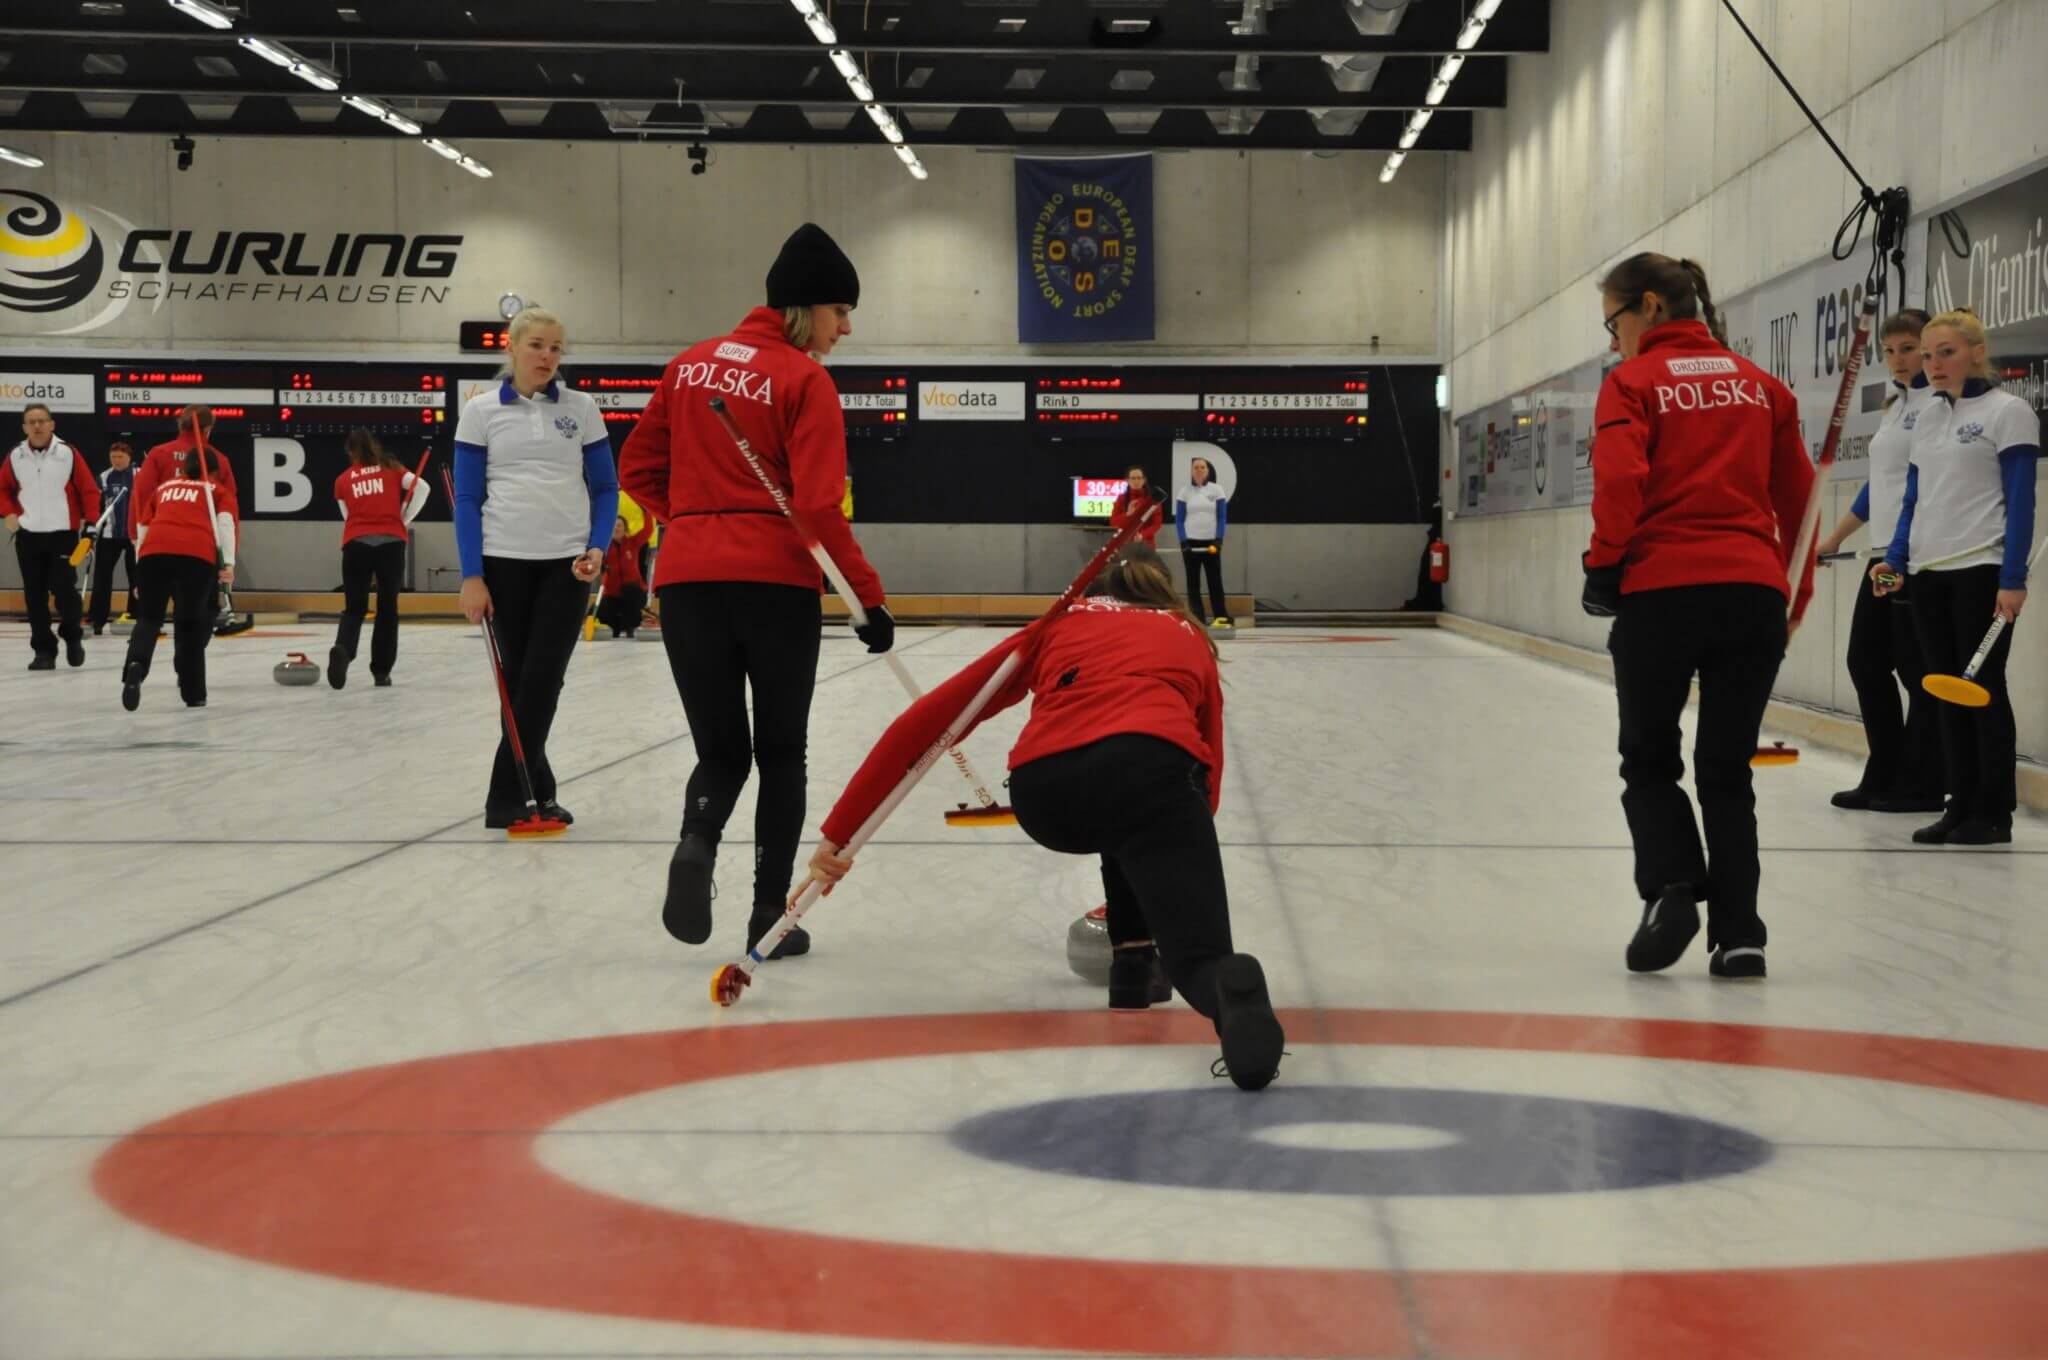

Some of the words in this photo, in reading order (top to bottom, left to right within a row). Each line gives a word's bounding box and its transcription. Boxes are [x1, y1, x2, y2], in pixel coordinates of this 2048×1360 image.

[1072, 183, 1136, 239] EUROPEAN
[118, 229, 465, 278] CURLING
[1032, 193, 1064, 309] ORGANIZATION
[1121, 245, 1137, 287] DEAF
[107, 279, 452, 305] SCHAFFHAUSEN
[1073, 289, 1123, 317] SPORT
[0, 380, 65, 399] todata
[112, 389, 139, 401] Rink
[143, 390, 151, 401] B
[674, 361, 773, 406] POLSKA
[1654, 378, 1770, 414] POLSKA
[283, 392, 290, 403] T
[295, 392, 300, 403] 1
[306, 392, 312, 403] 2
[316, 392, 322, 404] 3
[327, 393, 333, 404] 4
[338, 393, 344, 404] 5
[349, 393, 355, 404] 6
[359, 393, 365, 404] 7
[370, 393, 377, 404] 8
[381, 394, 388, 404] 9
[391, 394, 400, 405] 10
[402, 394, 409, 405] Z
[412, 394, 434, 405] Total
[612, 395, 620, 406] C
[844, 395, 850, 406] 9
[853, 395, 863, 406] 10
[865, 395, 872, 406] Z
[875, 395, 896, 406] Total
[1042, 396, 1068, 407] Rink
[1071, 396, 1080, 407] D
[1209, 396, 1216, 407] T
[1220, 396, 1225, 407] 1
[1230, 396, 1237, 407] 2
[1241, 396, 1247, 407] 3
[1251, 396, 1258, 407] 4
[1262, 396, 1268, 407] 5
[1272, 396, 1279, 407] 6
[1283, 396, 1289, 407] 7
[1294, 396, 1300, 407] 8
[1304, 396, 1311, 407] 9
[1314, 396, 1323, 407] 10
[1326, 396, 1332, 407] Z
[1335, 396, 1357, 407] Total
[254, 437, 313, 512] B
[1172, 441, 1237, 516] D
[160, 487, 199, 503] HUN
[351, 478, 384, 499] HUN
